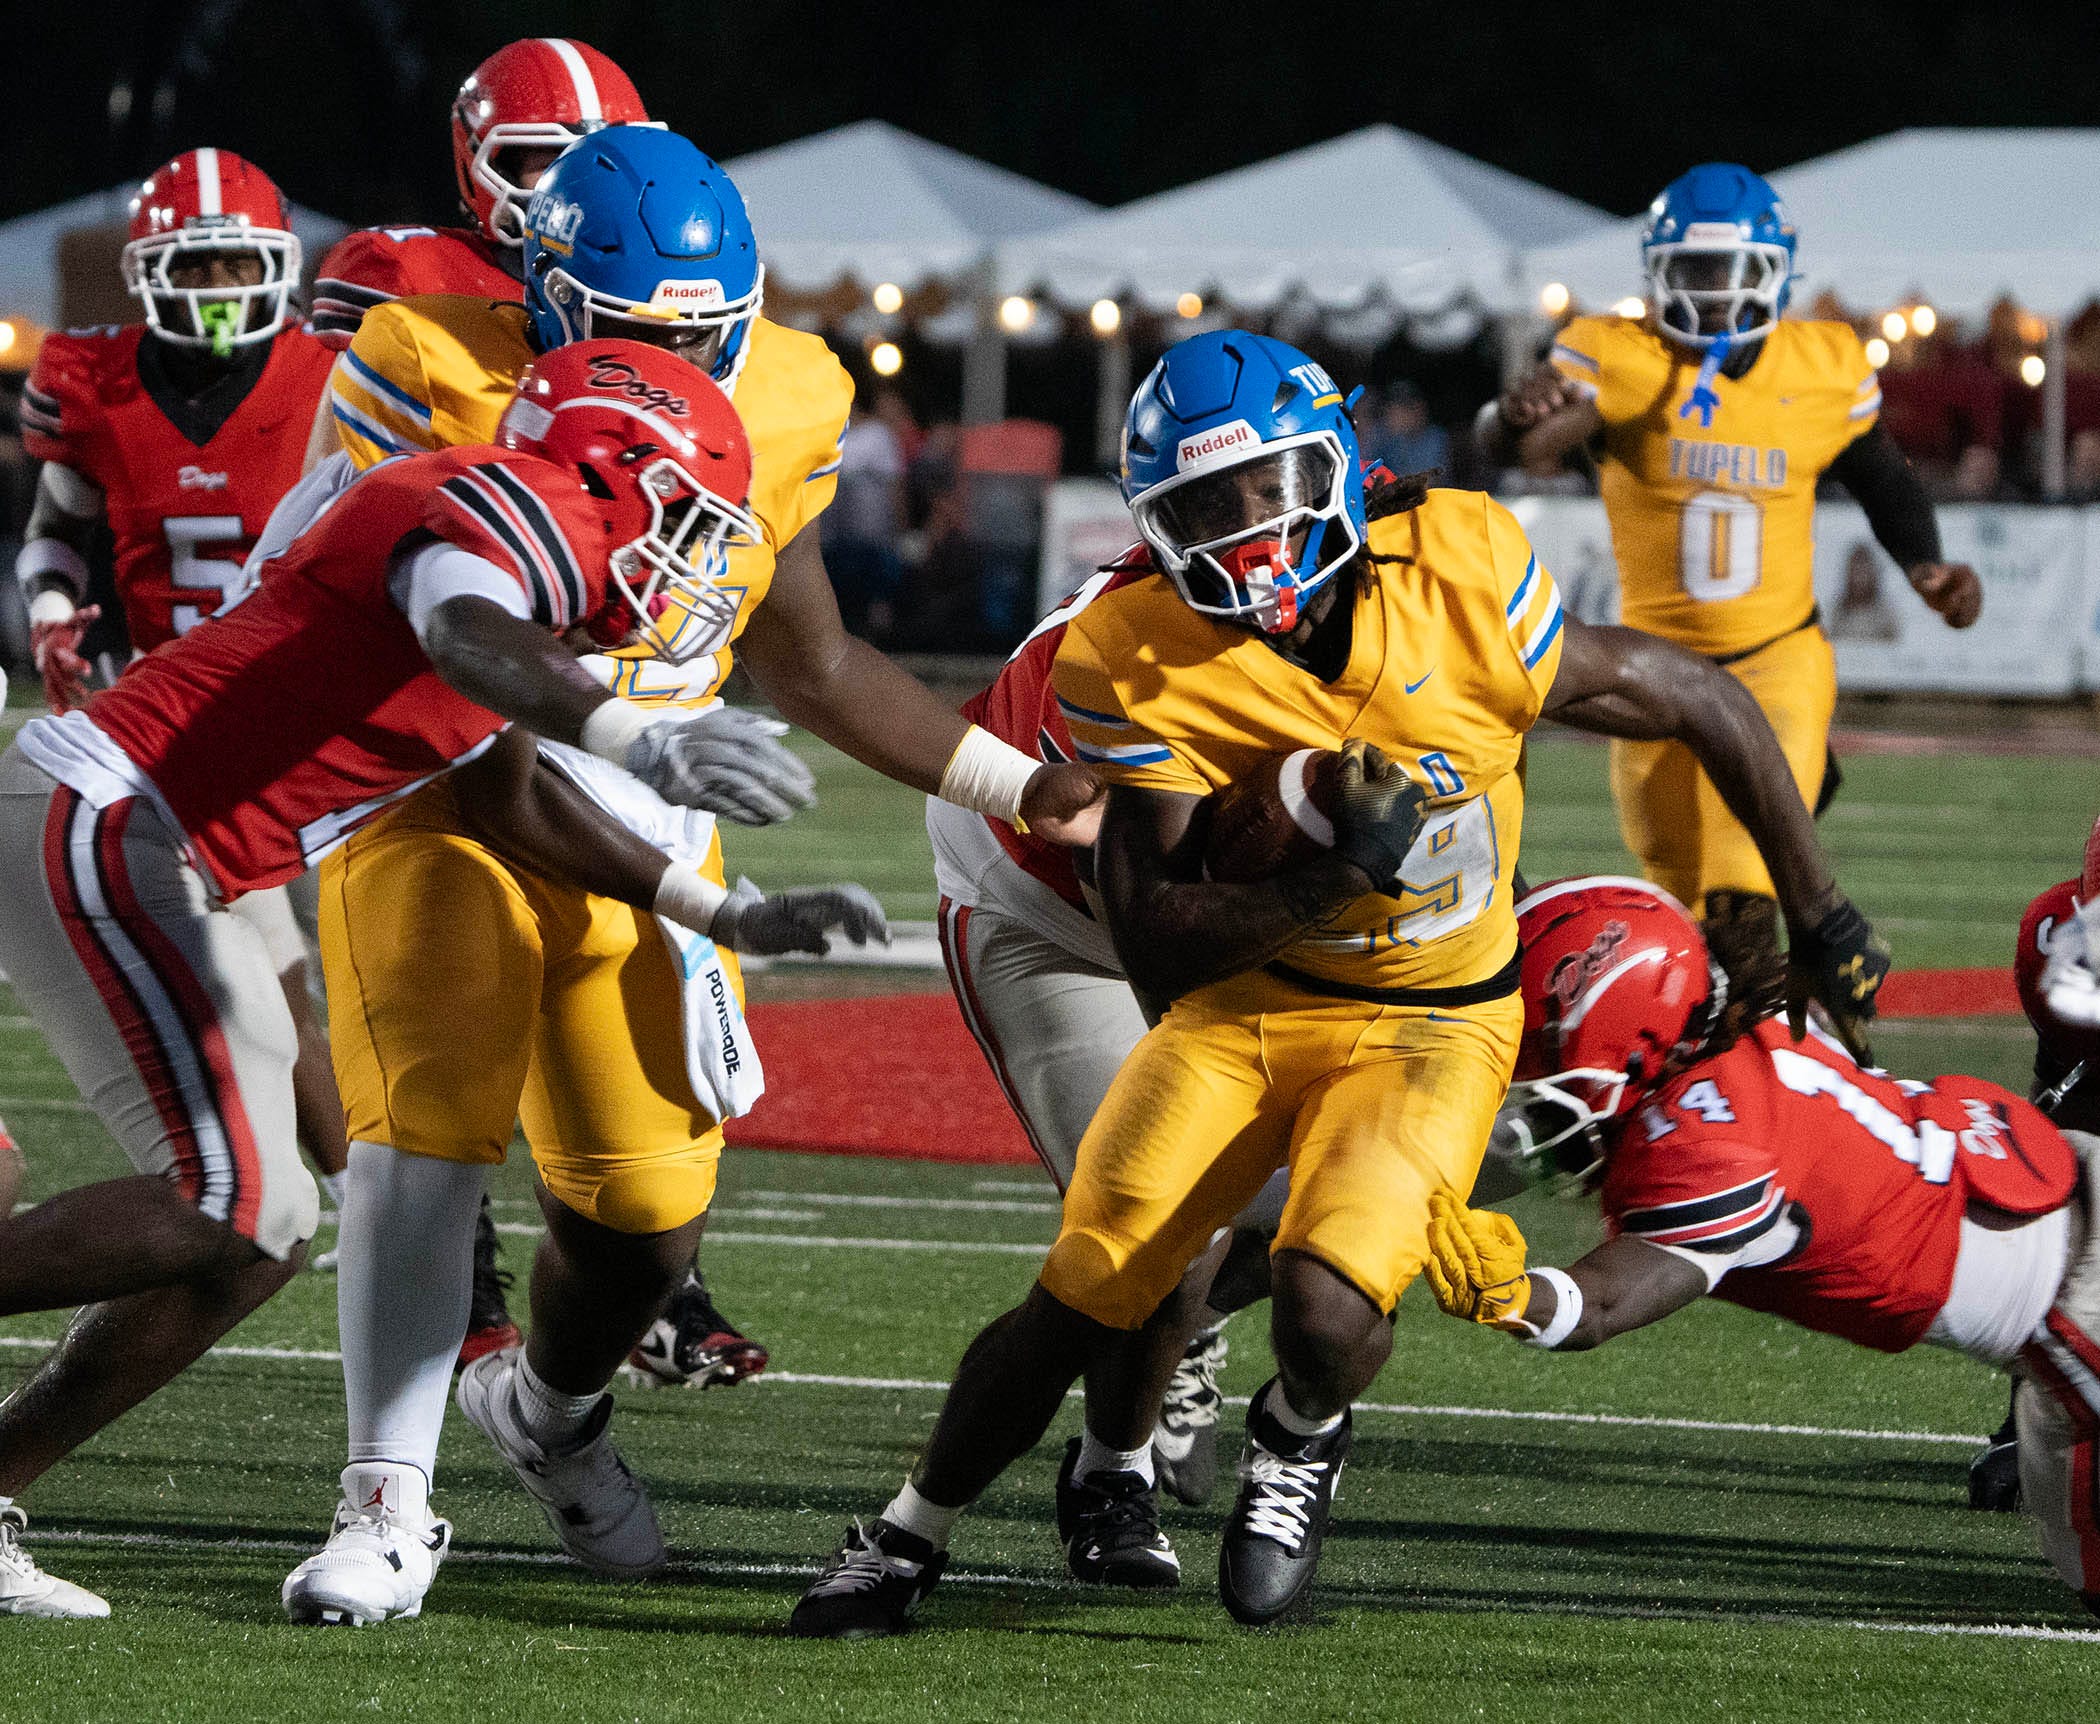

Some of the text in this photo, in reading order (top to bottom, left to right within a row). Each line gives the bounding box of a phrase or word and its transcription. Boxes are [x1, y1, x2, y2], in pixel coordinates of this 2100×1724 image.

[527, 192, 584, 241] PELO
[586, 355, 690, 416] Dogs
[1182, 427, 1248, 461] Riddell
[1670, 438, 1787, 489] TUPELO
[163, 516, 243, 636] 5
[1677, 491, 1765, 602] 0
[1640, 1079, 1736, 1143] 14
